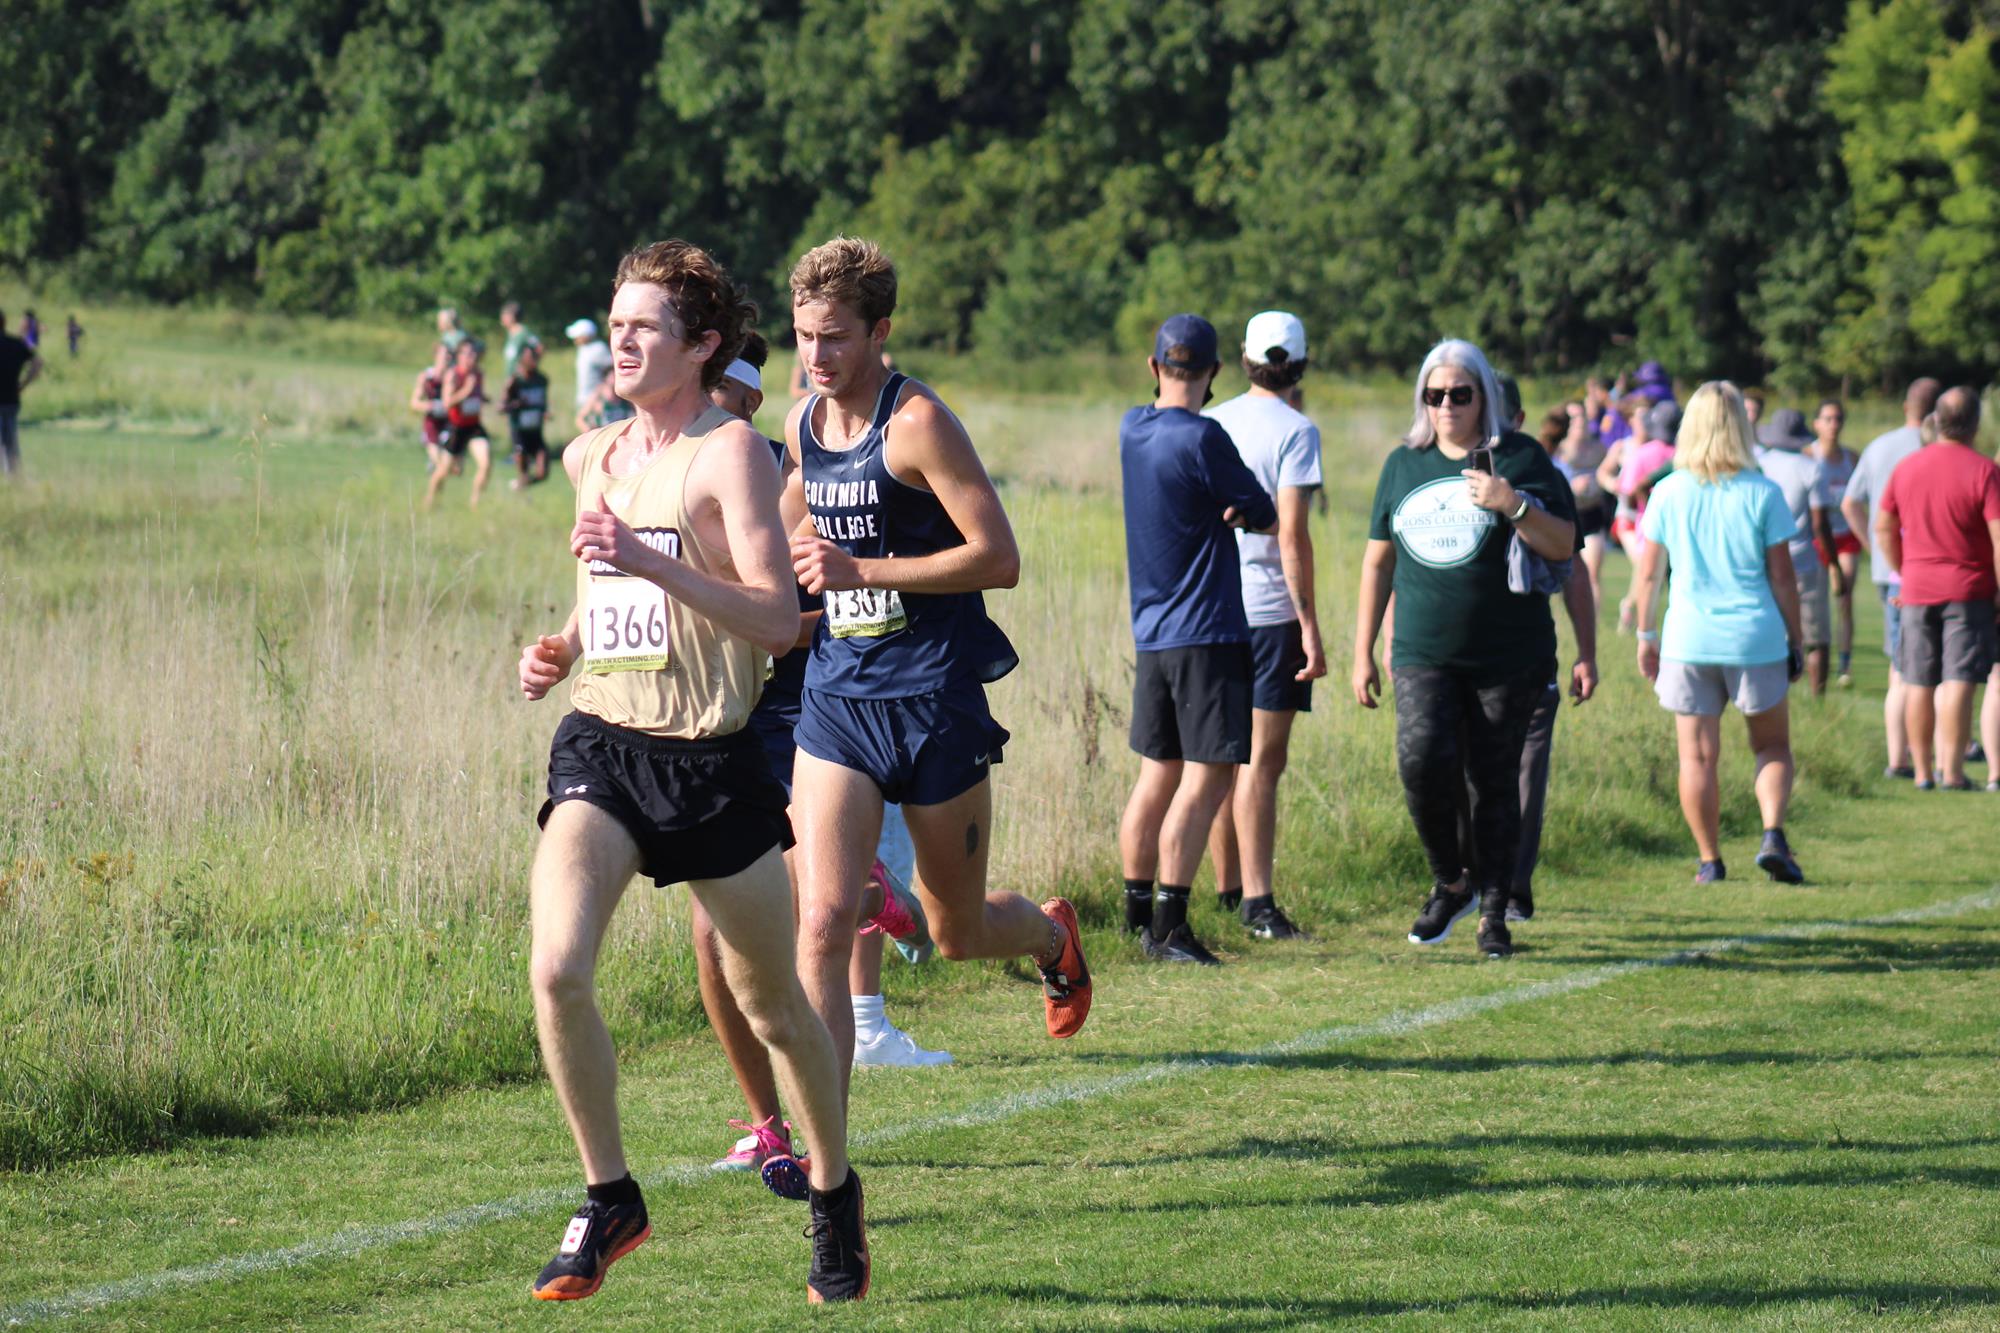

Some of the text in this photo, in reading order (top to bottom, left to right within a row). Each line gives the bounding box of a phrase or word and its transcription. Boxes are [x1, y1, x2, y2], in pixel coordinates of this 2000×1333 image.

[804, 479, 879, 508] COLUMBIA
[811, 513, 878, 540] COLLEGE
[1430, 535, 1458, 549] 2018
[589, 603, 665, 652] 1366
